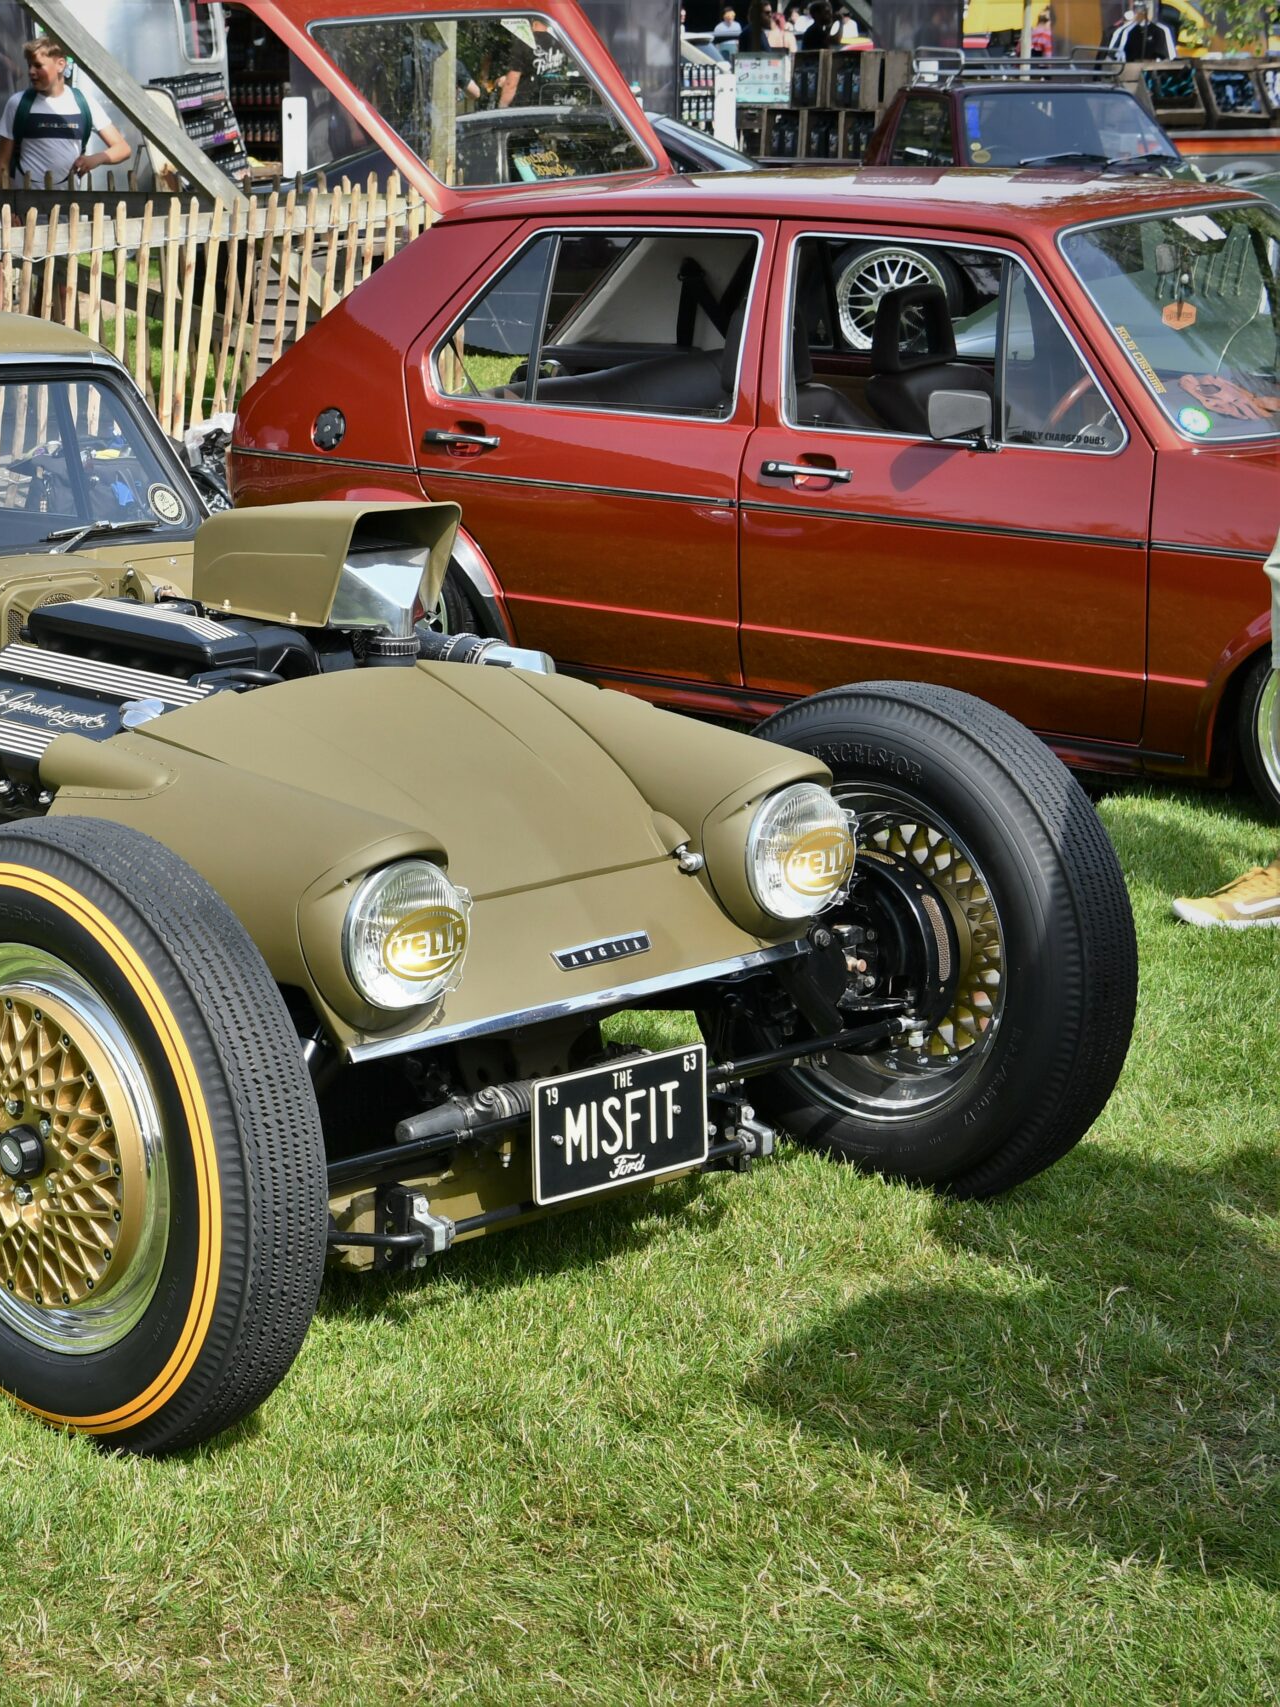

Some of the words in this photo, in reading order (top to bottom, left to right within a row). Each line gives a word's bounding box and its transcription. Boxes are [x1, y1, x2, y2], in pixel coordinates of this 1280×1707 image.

[1022, 430, 1043, 440] ONLY
[1083, 436, 1106, 445] DUBS
[391, 919, 465, 958] HELLA
[570, 939, 642, 965] ANGLIA
[683, 1053, 697, 1073] 63
[612, 1069, 633, 1090] THE
[545, 1087, 559, 1106] 19
[565, 1080, 680, 1166] MISFIT
[609, 1152, 646, 1179] Ford
